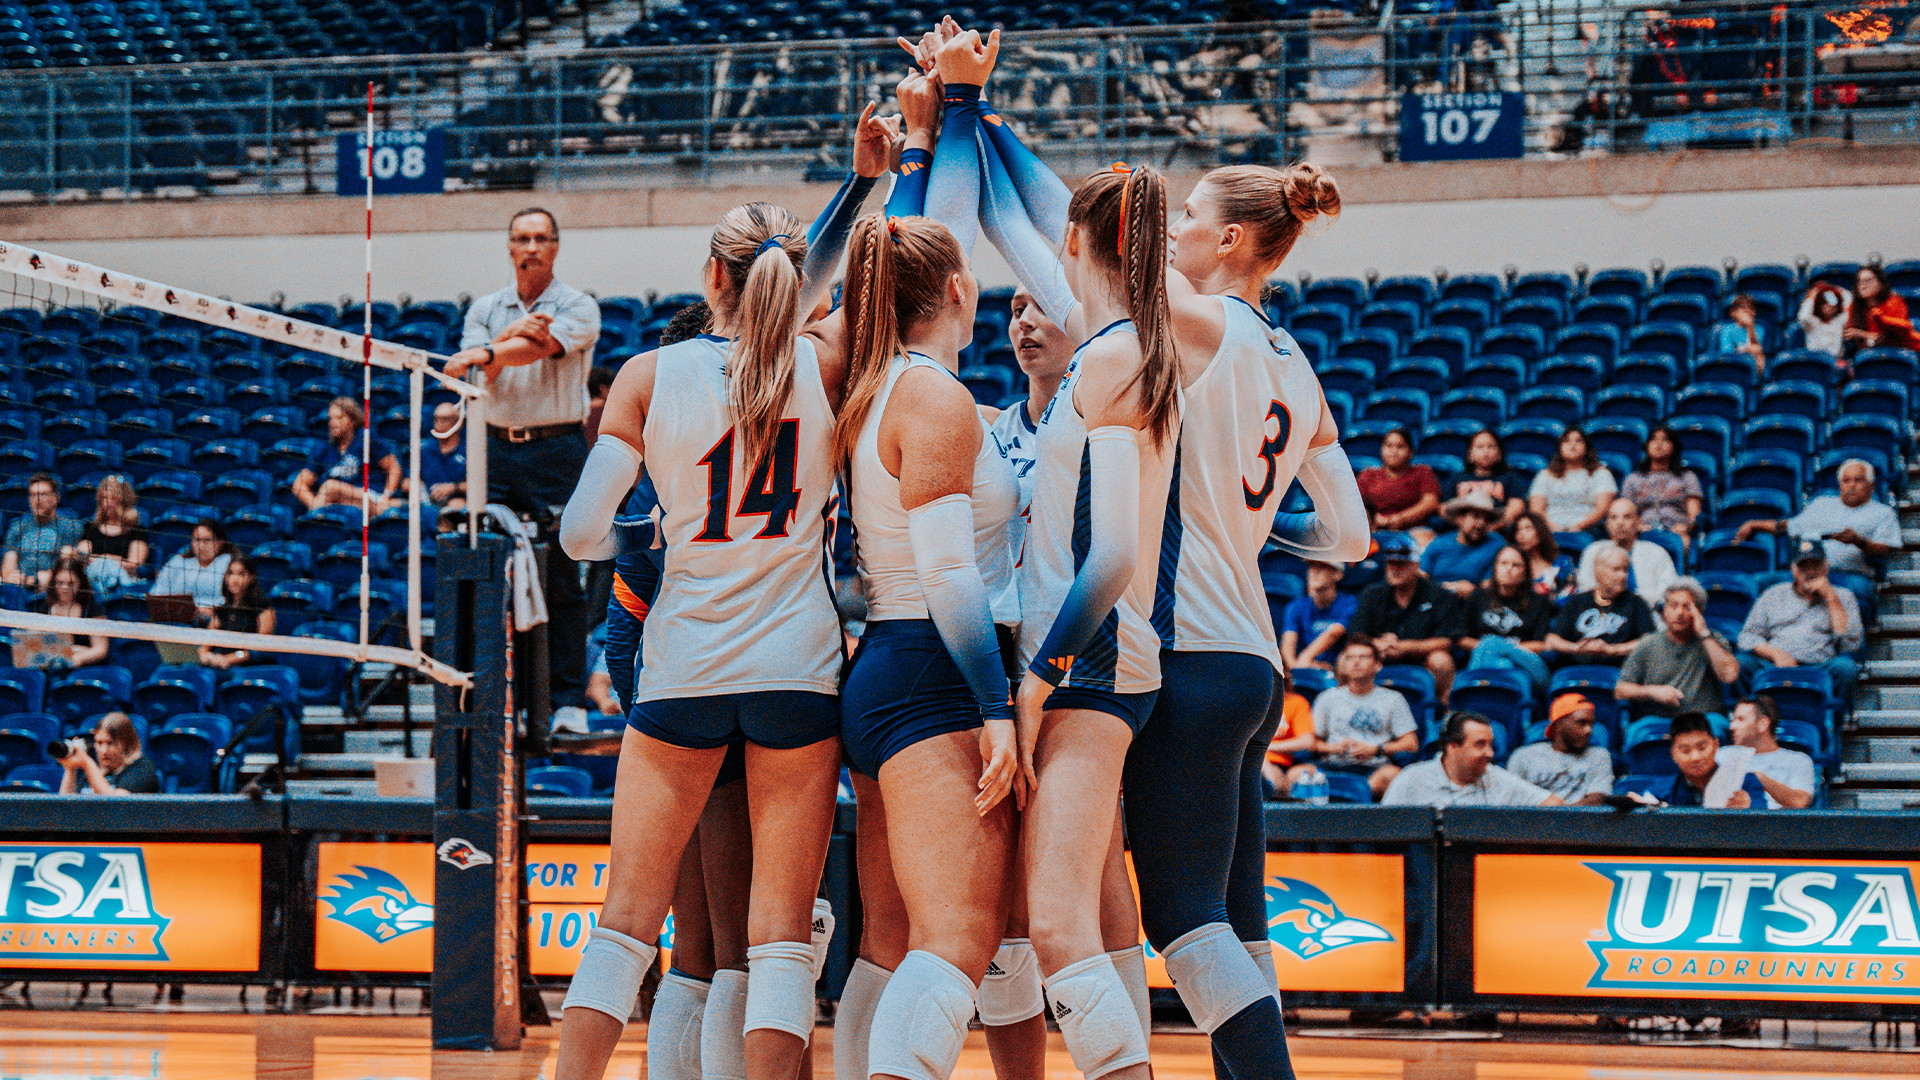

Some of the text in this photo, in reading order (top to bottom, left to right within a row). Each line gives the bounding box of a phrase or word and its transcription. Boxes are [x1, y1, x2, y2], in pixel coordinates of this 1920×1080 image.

[1422, 93, 1502, 108] SECTION
[1422, 109, 1501, 144] 107
[357, 146, 426, 179] 108
[1242, 399, 1292, 511] 3
[690, 418, 802, 542] 14
[526, 863, 577, 886] FOR
[1614, 869, 1920, 947] UTSA
[1628, 957, 1905, 981] ROADRUNNERS
